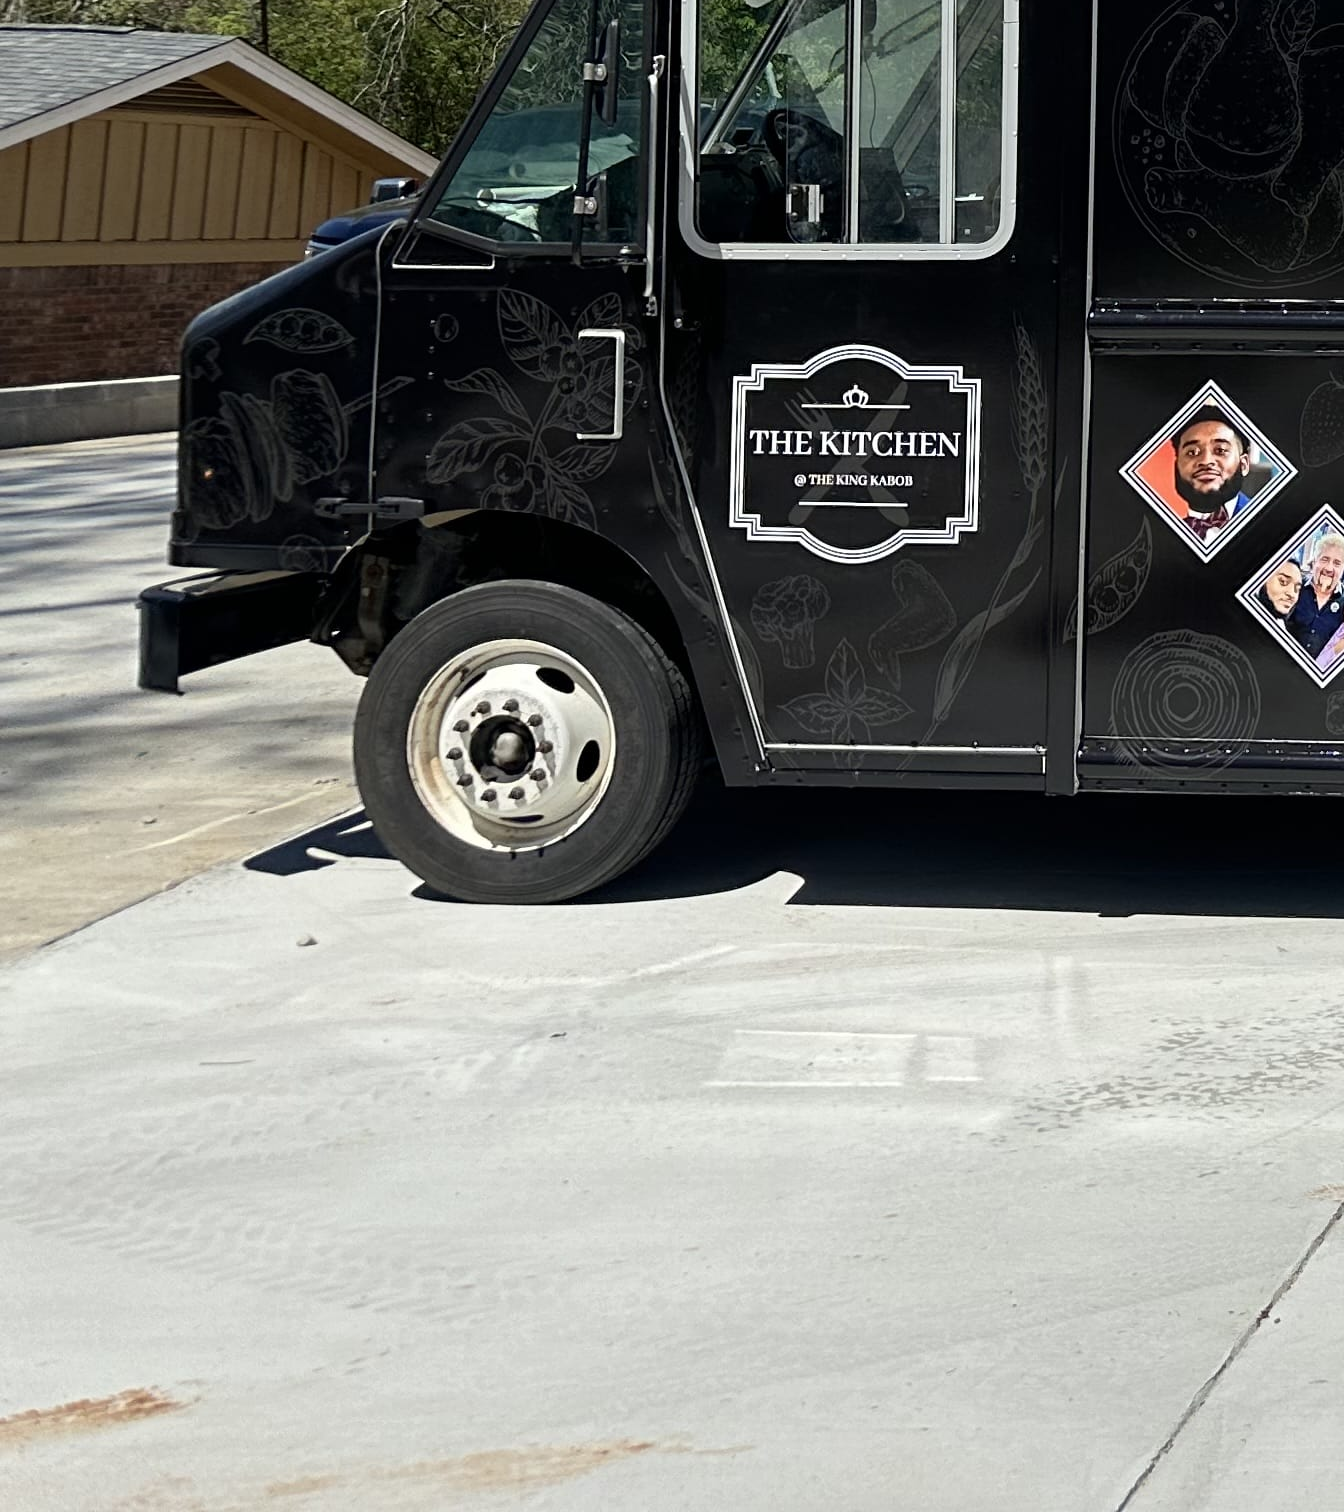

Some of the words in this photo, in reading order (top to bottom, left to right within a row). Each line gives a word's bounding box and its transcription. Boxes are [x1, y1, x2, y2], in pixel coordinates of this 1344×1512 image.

[748, 429, 814, 456] THE
[817, 430, 962, 458] KITCHEN
[793, 474, 807, 487] @
[808, 473, 835, 486] THE
[835, 474, 868, 487] KING
[869, 474, 914, 487] KABOB
